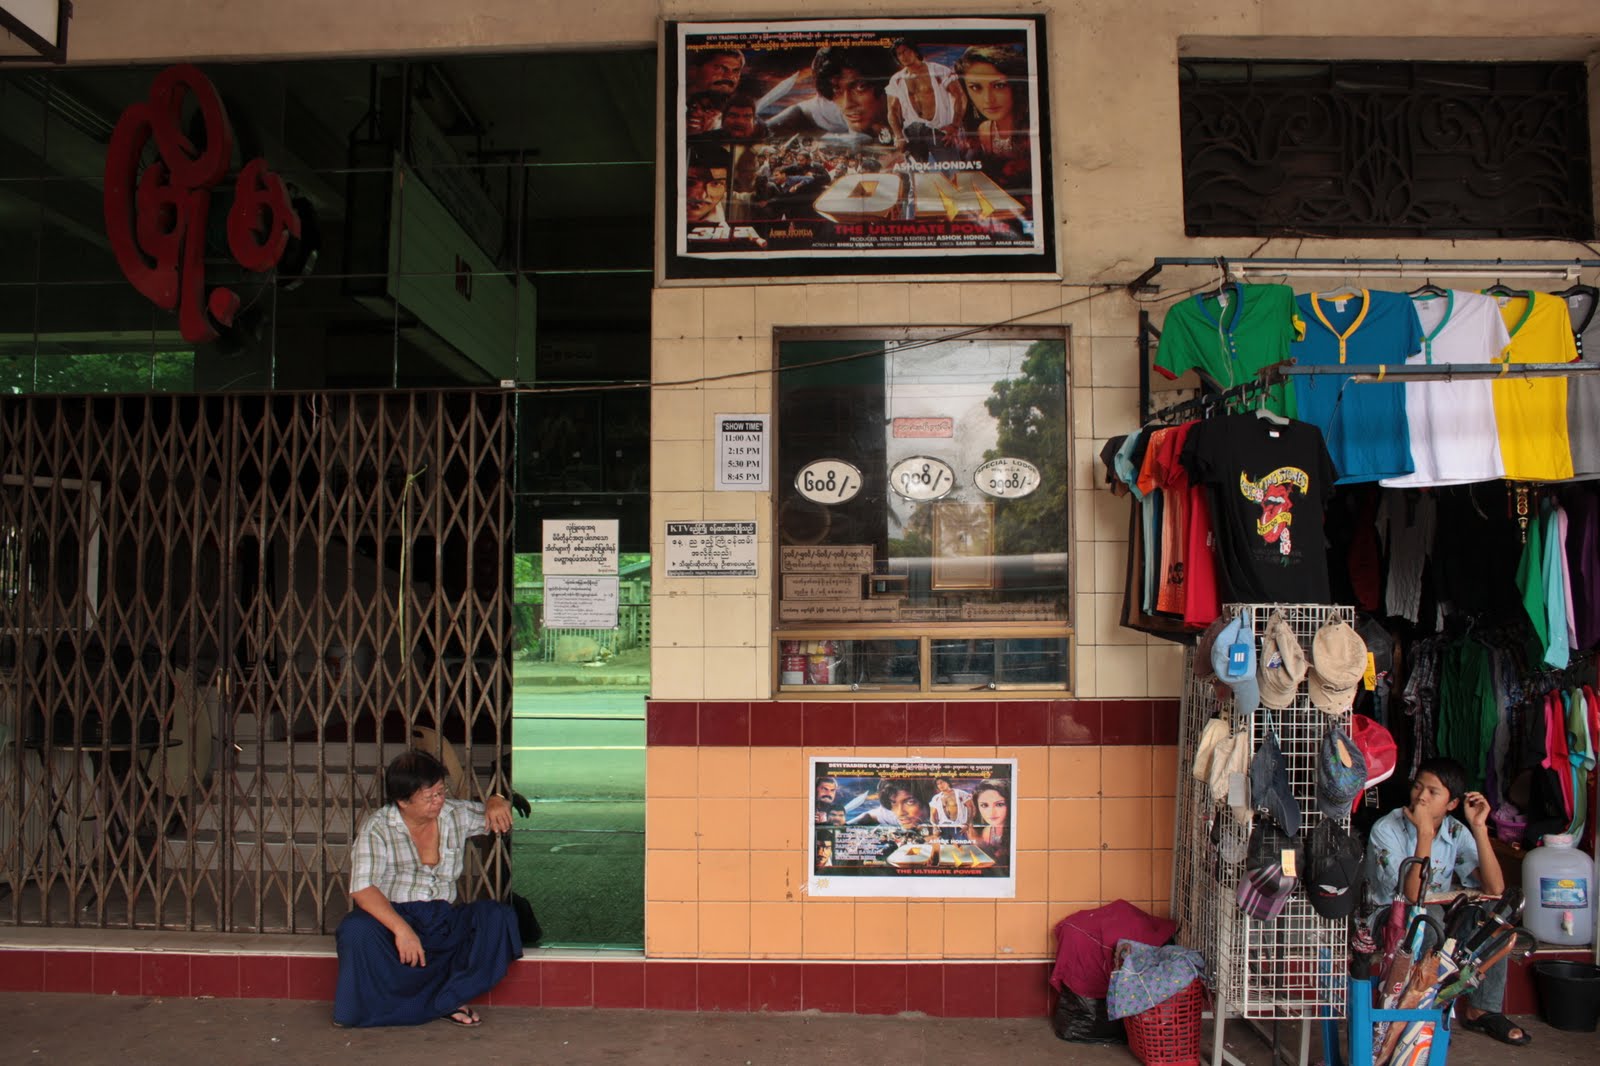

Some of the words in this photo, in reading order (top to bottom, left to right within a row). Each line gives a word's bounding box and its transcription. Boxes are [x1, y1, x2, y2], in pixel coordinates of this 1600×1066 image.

[892, 161, 931, 172] ASHOK
[934, 160, 983, 170] HONDA'S
[813, 172, 1026, 222] OM
[833, 225, 864, 235] THE
[868, 224, 945, 235] ULTIMATE
[951, 222, 1011, 234] POWER
[725, 434, 744, 442] 11:00
[745, 434, 760, 442] AM
[728, 447, 744, 455] 2:15
[746, 447, 760, 455] PM
[728, 460, 744, 468] 5:30
[746, 460, 760, 468] PM
[977, 459, 1008, 475] SPECIAL
[1012, 459, 1038, 474] LODGE
[727, 473, 744, 481] 8:45
[746, 473, 760, 481] PM
[886, 843, 997, 868] OM
